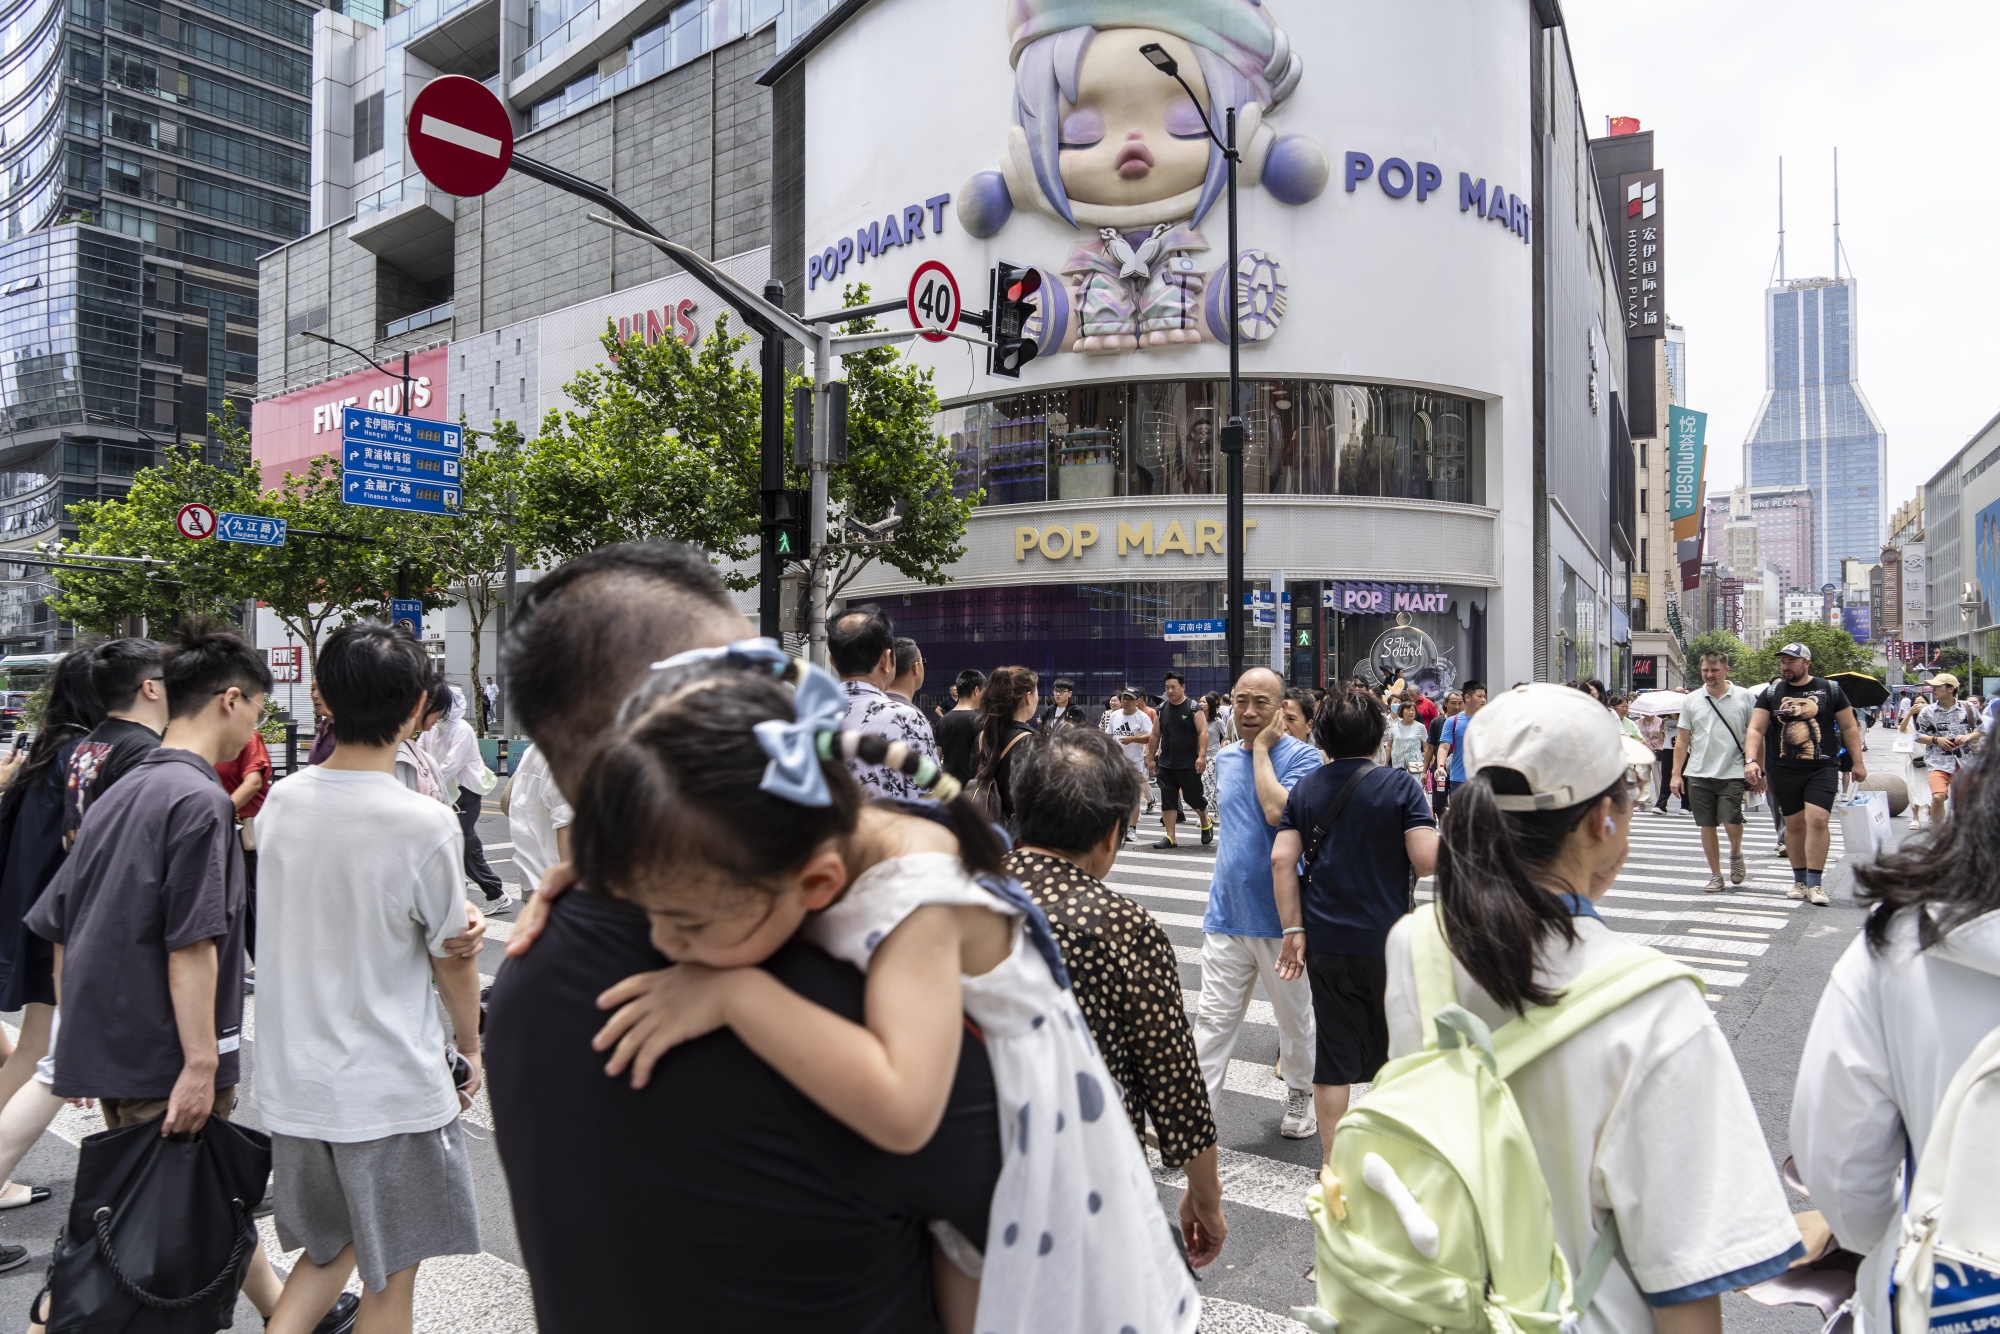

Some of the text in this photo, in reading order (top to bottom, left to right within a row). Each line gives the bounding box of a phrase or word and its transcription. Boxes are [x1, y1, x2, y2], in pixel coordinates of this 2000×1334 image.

[1345, 150, 1532, 244] POP MART
[809, 192, 950, 290] POP MART
[1628, 230, 1638, 328] HONGYI PLAZA
[1642, 226, 1657, 325] 宏伊国际广场
[918, 279, 950, 324] 40
[364, 416, 412, 434] 宏伊国际广场
[364, 430, 412, 442] Hongyi Plaza
[447, 434, 455, 444] P
[364, 447, 411, 464] 黄浦体育馆
[447, 463, 455, 474] P
[364, 478, 411, 494] 金融广场
[364, 492, 412, 503] Finance Square
[1772, 499, 1798, 507] PLAZA
[232, 520, 272, 534] 九江路
[234, 532, 258, 540] Jiujiang
[1016, 522, 1099, 560] POP
[394, 604, 420, 612] 九江路口
[1344, 590, 1448, 612] POP MART
[1178, 622, 1212, 632] 河南中路
[1381, 636, 1423, 658] Sound
[1395, 636, 1410, 648] The
[273, 648, 296, 664] FIVE
[272, 666, 298, 680] GUYS
